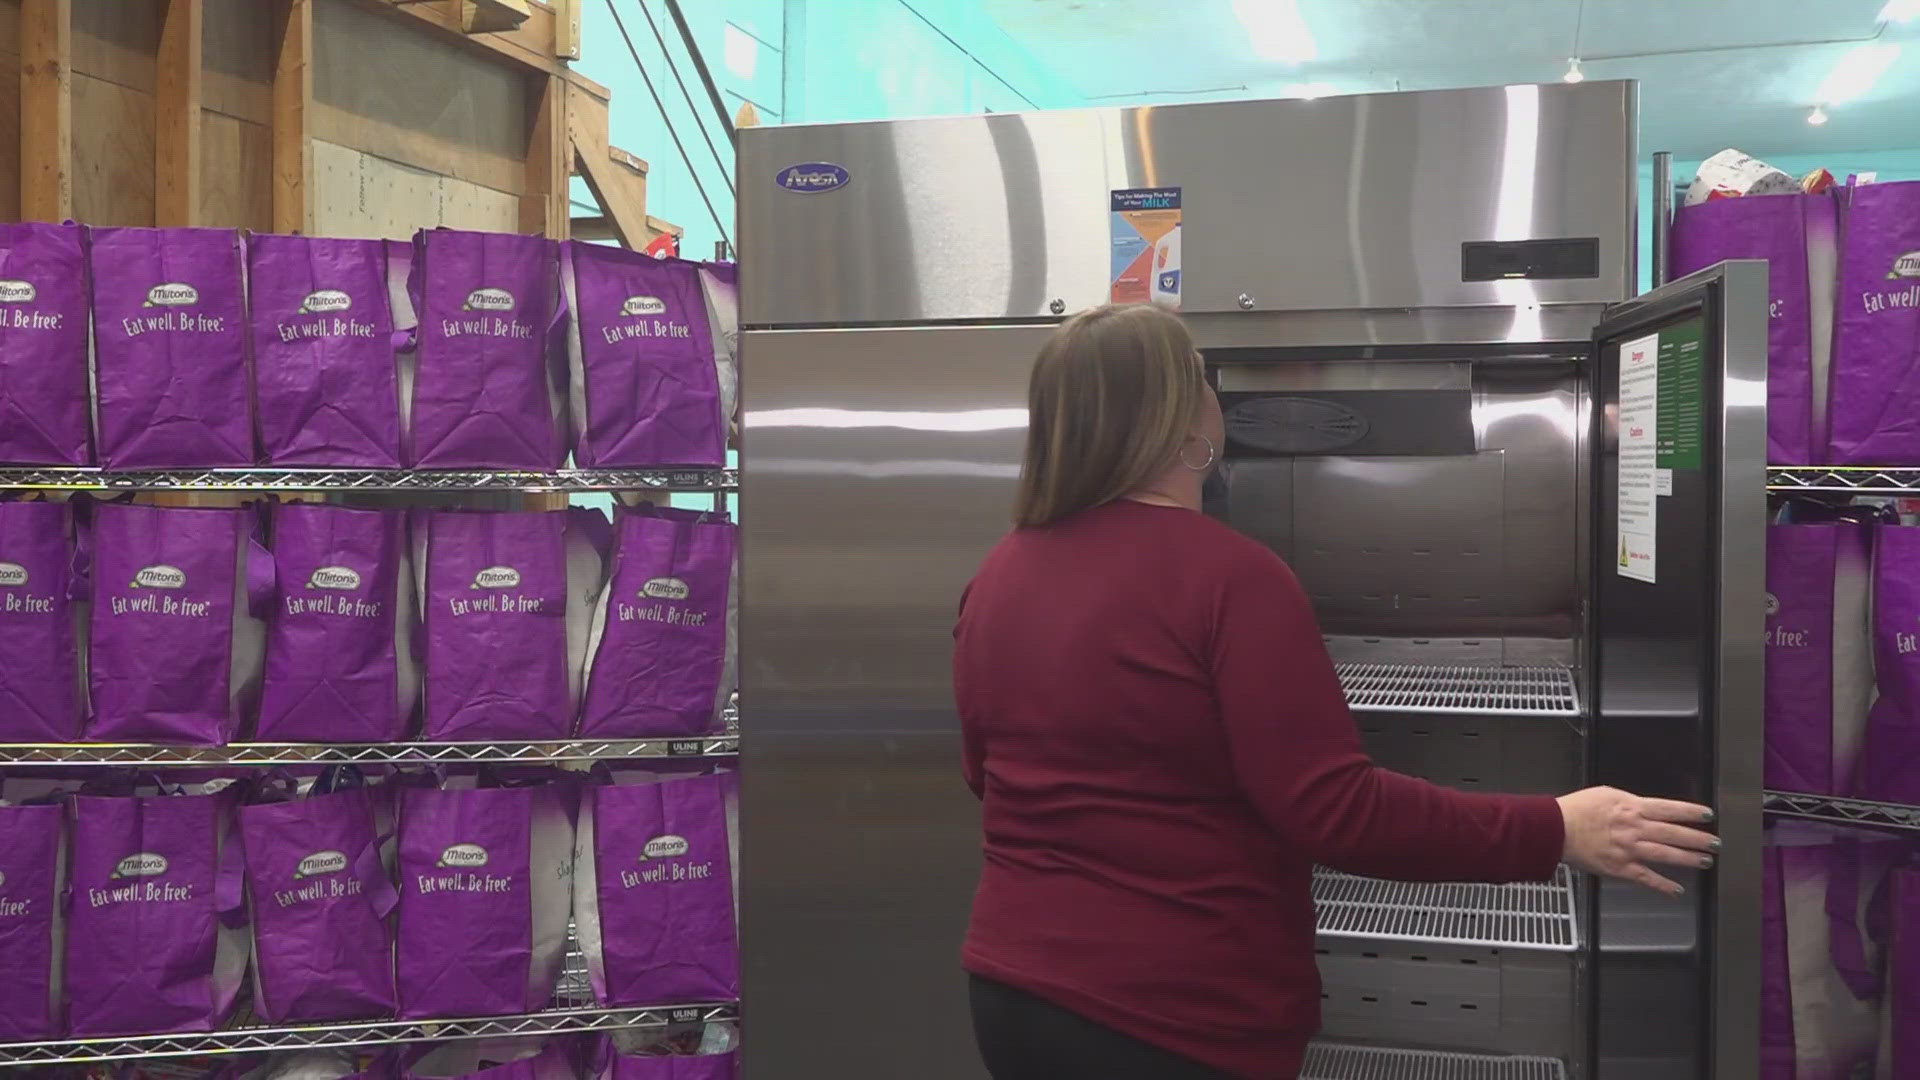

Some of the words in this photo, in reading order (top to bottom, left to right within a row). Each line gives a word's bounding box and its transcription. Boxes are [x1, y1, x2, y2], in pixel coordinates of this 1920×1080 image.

[1142, 198, 1170, 208] MILK
[1863, 293, 1884, 313] Eat
[14, 310, 29, 328] Be
[123, 318, 144, 336] Eat
[147, 313, 175, 330] well.
[181, 313, 194, 330] Be
[443, 320, 460, 337] Eat
[464, 319, 490, 335] well.
[494, 318, 507, 336] Be
[278, 324, 299, 341] Eat
[302, 320, 330, 337] well.
[334, 319, 348, 335] Be
[602, 327, 623, 343] Eat
[625, 321, 651, 337] well.
[654, 322, 666, 336] Be
[7, 593, 21, 611] Be
[112, 597, 127, 614] Eat
[131, 595, 158, 612] well.
[163, 596, 177, 614] Be
[287, 596, 304, 614] Eat
[308, 596, 334, 613] well.
[338, 597, 352, 615] Be
[450, 599, 469, 615] Eat
[473, 596, 497, 611] well.
[502, 595, 514, 611] Be
[619, 604, 633, 620] Eat
[638, 605, 663, 621] well.
[667, 607, 680, 623] Be
[1897, 633, 1916, 653] Eat
[673, 742, 699, 751] ULINE
[419, 876, 435, 893] Eat
[439, 875, 464, 890] well.
[469, 875, 482, 891] Be
[621, 871, 640, 888] Eat
[642, 864, 668, 882] well.
[673, 863, 685, 880] Be
[90, 889, 109, 907] Eat
[113, 885, 141, 901] well.
[146, 883, 160, 901] Be
[275, 891, 296, 907] Eat
[298, 881, 327, 900] well.
[331, 879, 344, 896] Be
[348, 877, 361, 896] fre
[673, 1009, 698, 1018] ULINE
